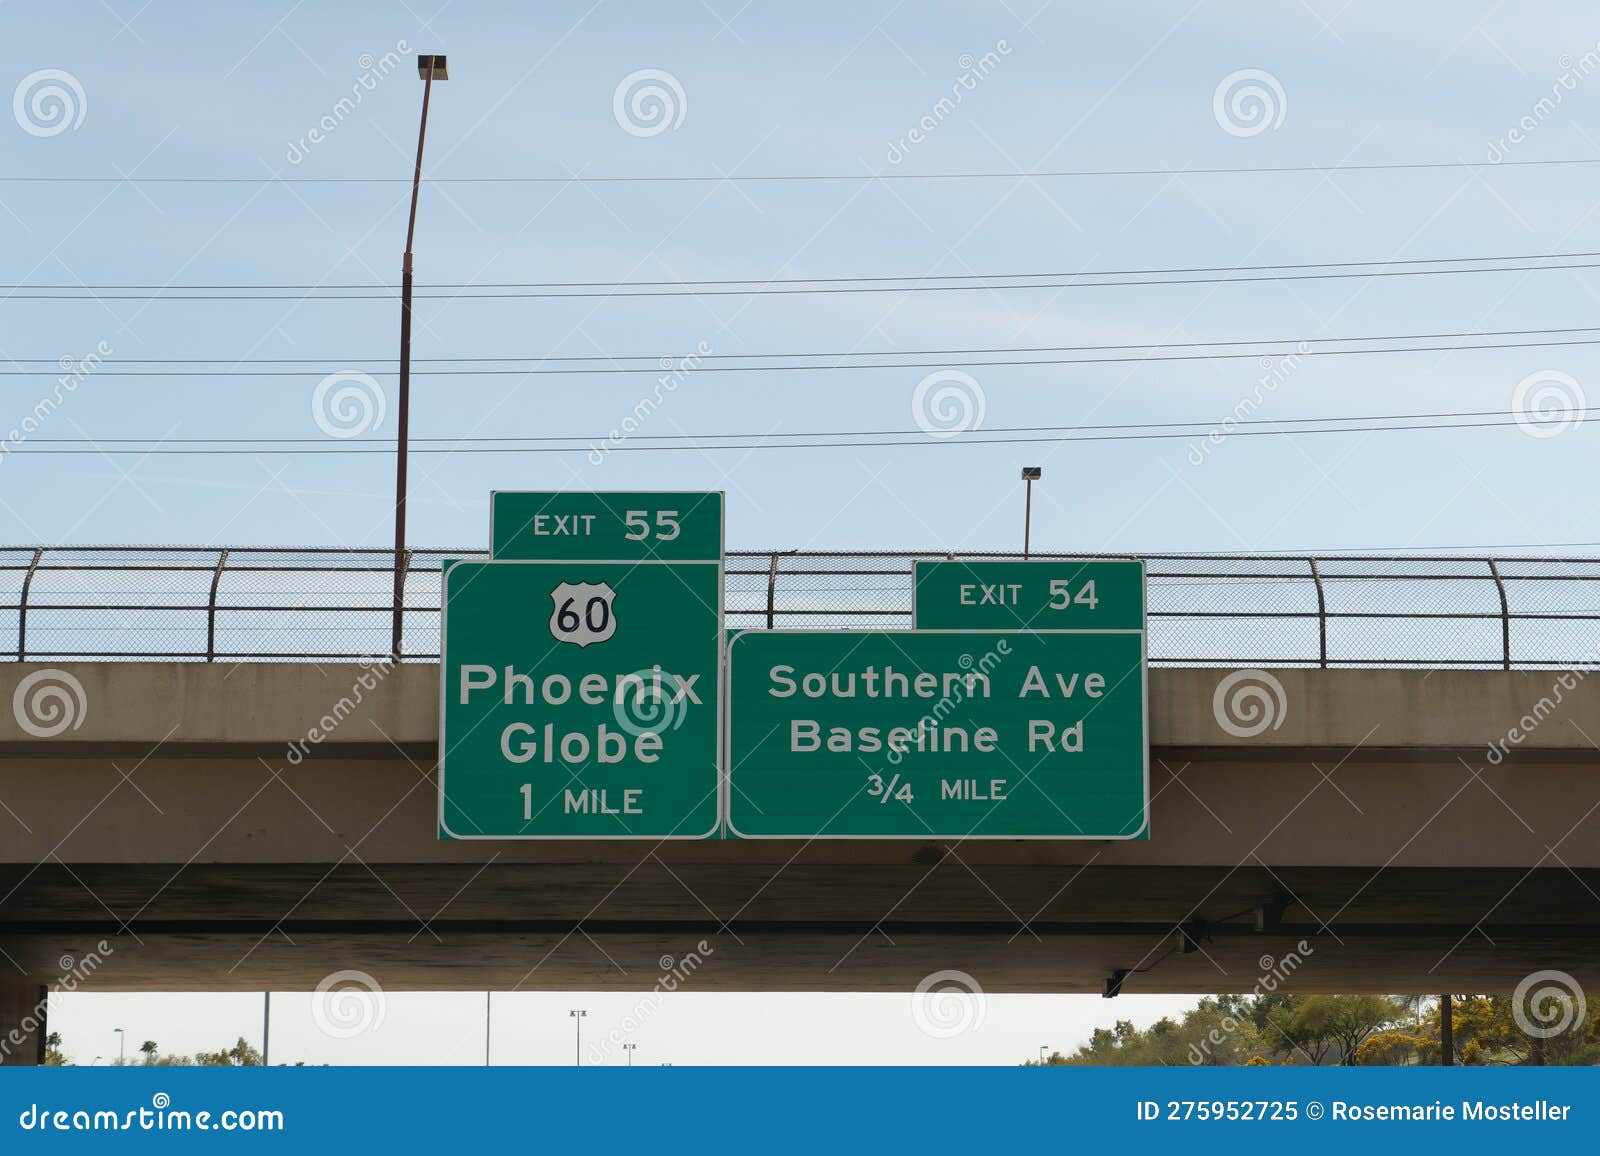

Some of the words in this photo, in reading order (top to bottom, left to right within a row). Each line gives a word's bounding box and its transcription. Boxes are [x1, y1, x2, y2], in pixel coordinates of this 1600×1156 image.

[535, 515, 595, 535] EXIT
[625, 511, 680, 541] 55
[960, 584, 1022, 605] EXIT
[1049, 579, 1098, 610] 54
[557, 596, 609, 633] 60
[459, 664, 703, 705] Phoenix
[768, 664, 991, 698] Southern
[1019, 665, 1106, 698] Ave
[500, 722, 664, 763] Globe
[790, 719, 998, 753] Baseline
[1028, 719, 1084, 754] Rd
[519, 783, 532, 820] 1
[564, 789, 642, 814] MILE
[867, 774, 914, 803] 3/4
[941, 779, 1007, 800] MILE
